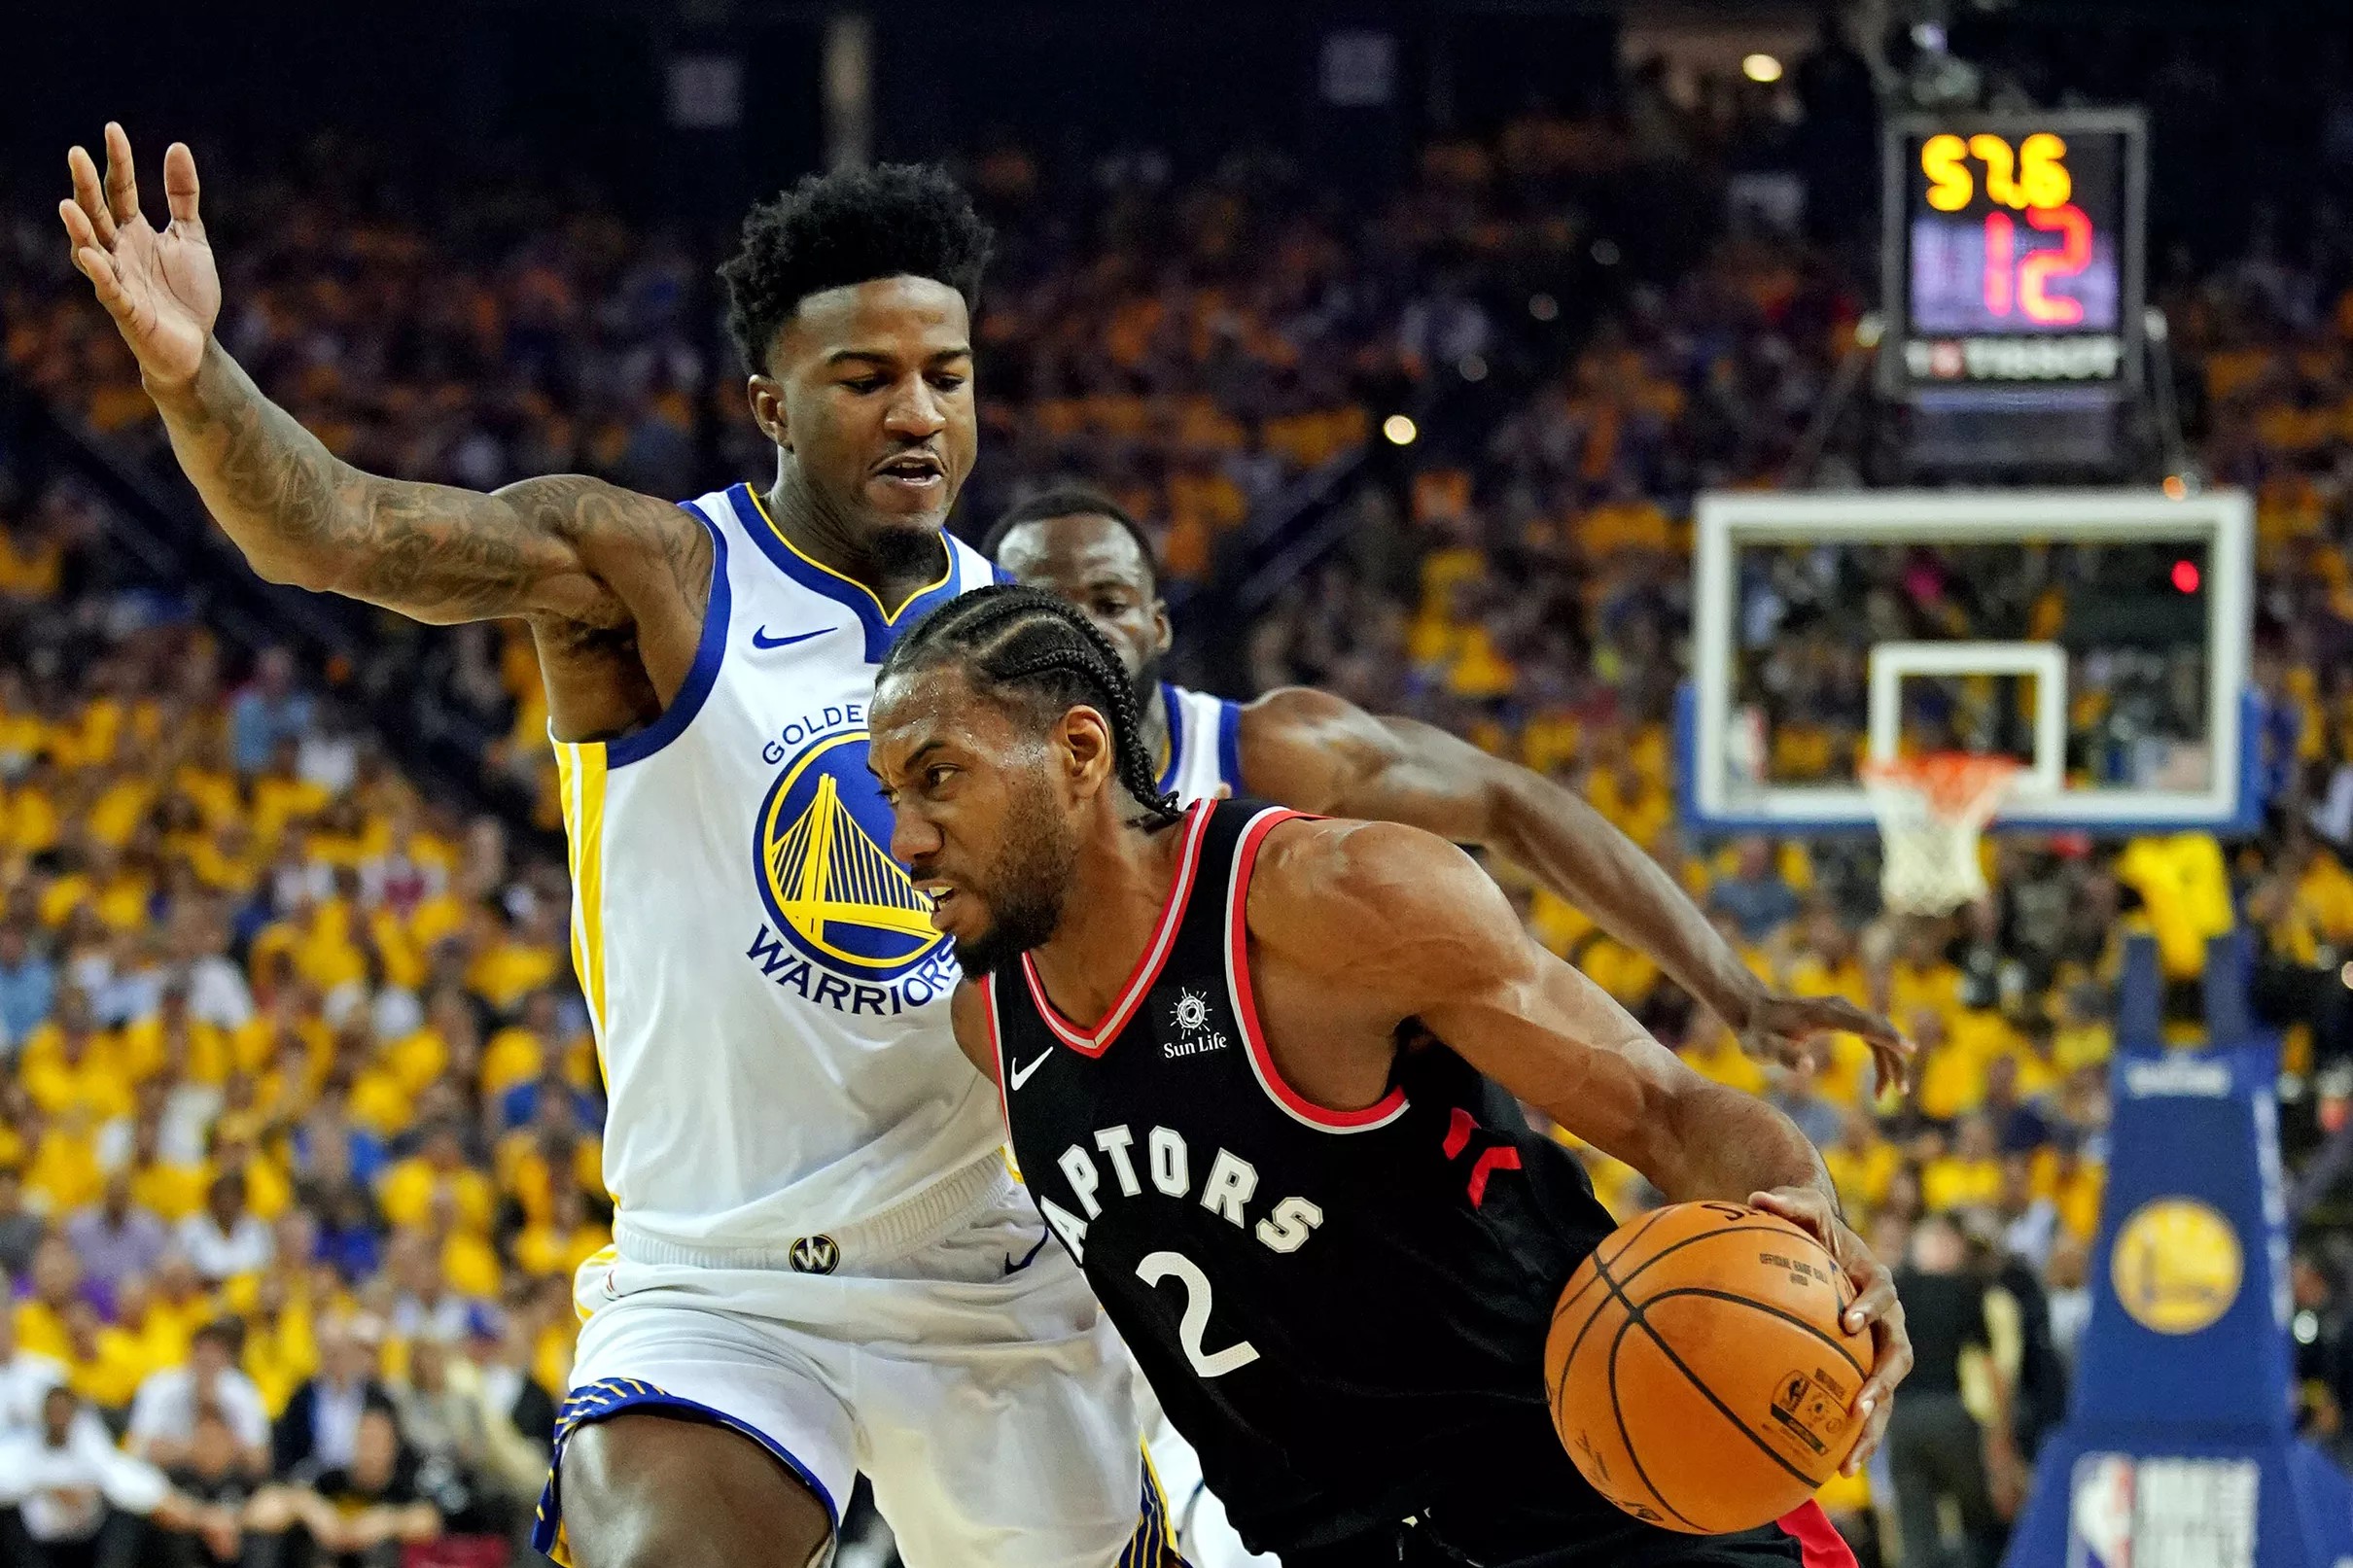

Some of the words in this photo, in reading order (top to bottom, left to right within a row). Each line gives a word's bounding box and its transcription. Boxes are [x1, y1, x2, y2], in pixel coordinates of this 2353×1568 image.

[1984, 203, 2092, 325] 12
[761, 703, 864, 766] GOLDE
[746, 923, 958, 1017] WARRIORS
[1163, 1042, 1196, 1059] Sun
[1197, 1031, 1227, 1052] Life
[1040, 1124, 1323, 1264] APTORS
[1135, 1251, 1261, 1378] 2
